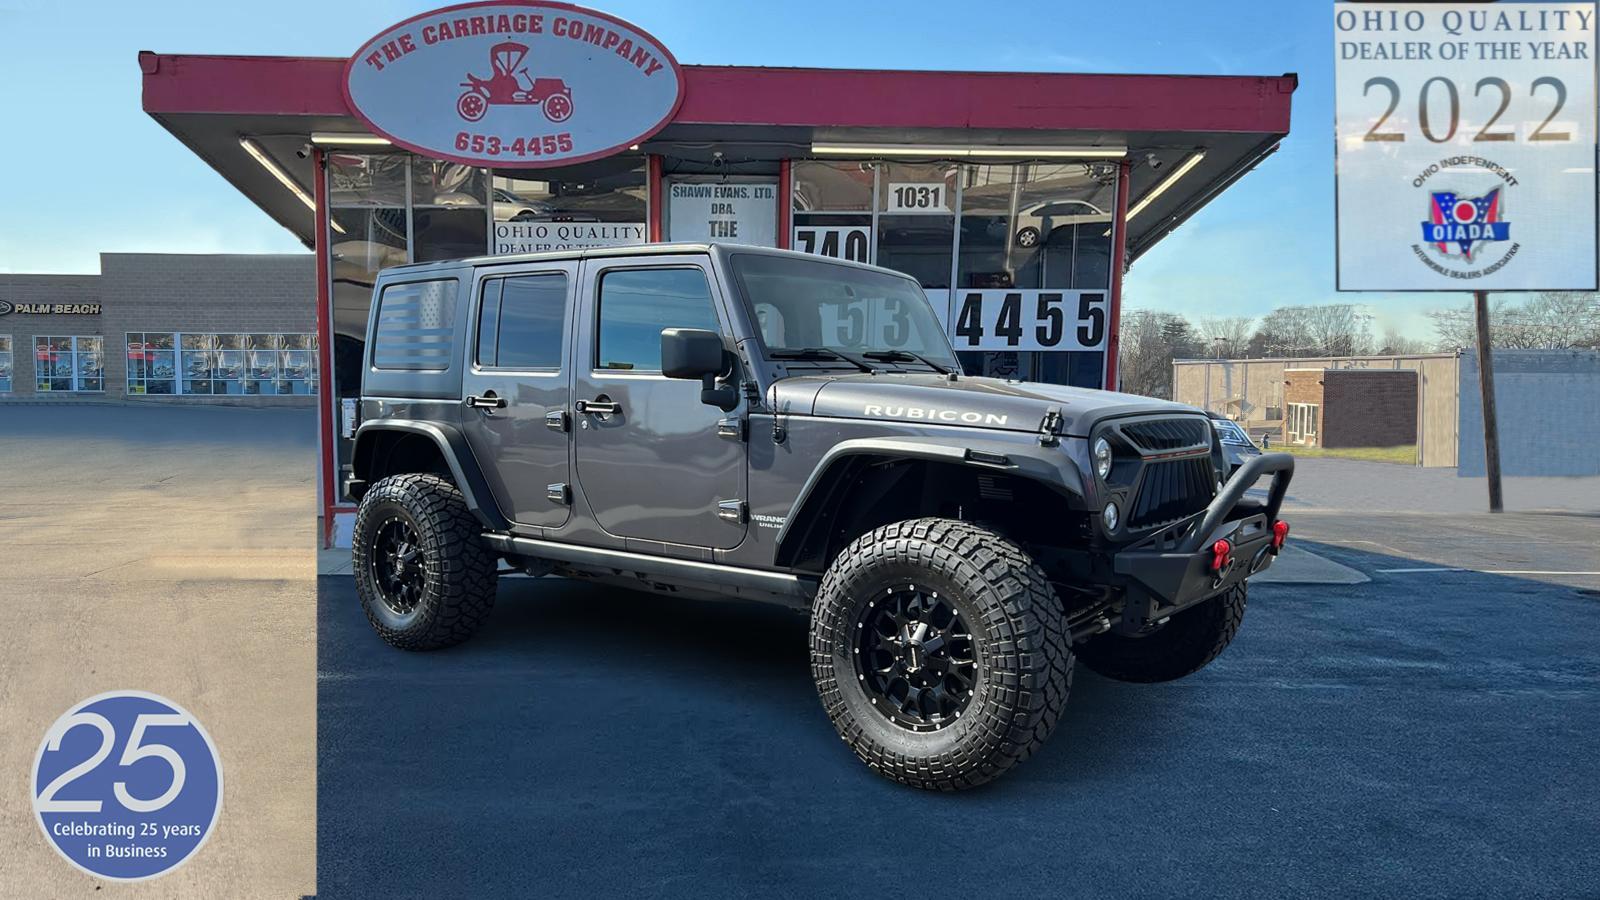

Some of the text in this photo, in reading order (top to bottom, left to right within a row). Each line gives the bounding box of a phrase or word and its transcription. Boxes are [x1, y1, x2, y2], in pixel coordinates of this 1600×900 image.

[1336, 10, 1592, 35] OHIO QUALITY
[366, 14, 663, 77] THE CARRIAGE COMPANY
[1340, 42, 1588, 60] DEALER OF THE YEAR
[1363, 76, 1570, 143] 2022
[455, 132, 573, 156] 653-4455
[1412, 156, 1519, 188] OHIO INDEPENDENT
[673, 186, 711, 199] SHAWN
[753, 187, 774, 199] LTD.
[894, 187, 940, 208] 1031
[711, 204, 736, 214] DBA.
[497, 226, 644, 240] OHIO QUALITY
[708, 221, 737, 237] THE
[1433, 224, 1495, 240] OIADA
[798, 230, 867, 264] 740
[1411, 242, 1520, 279] AUTOMOBILE DEALERS ASSOCIATION
[15, 303, 100, 314] PALM BEACH
[956, 293, 1105, 347] 4455
[864, 404, 1008, 425] RUBICON
